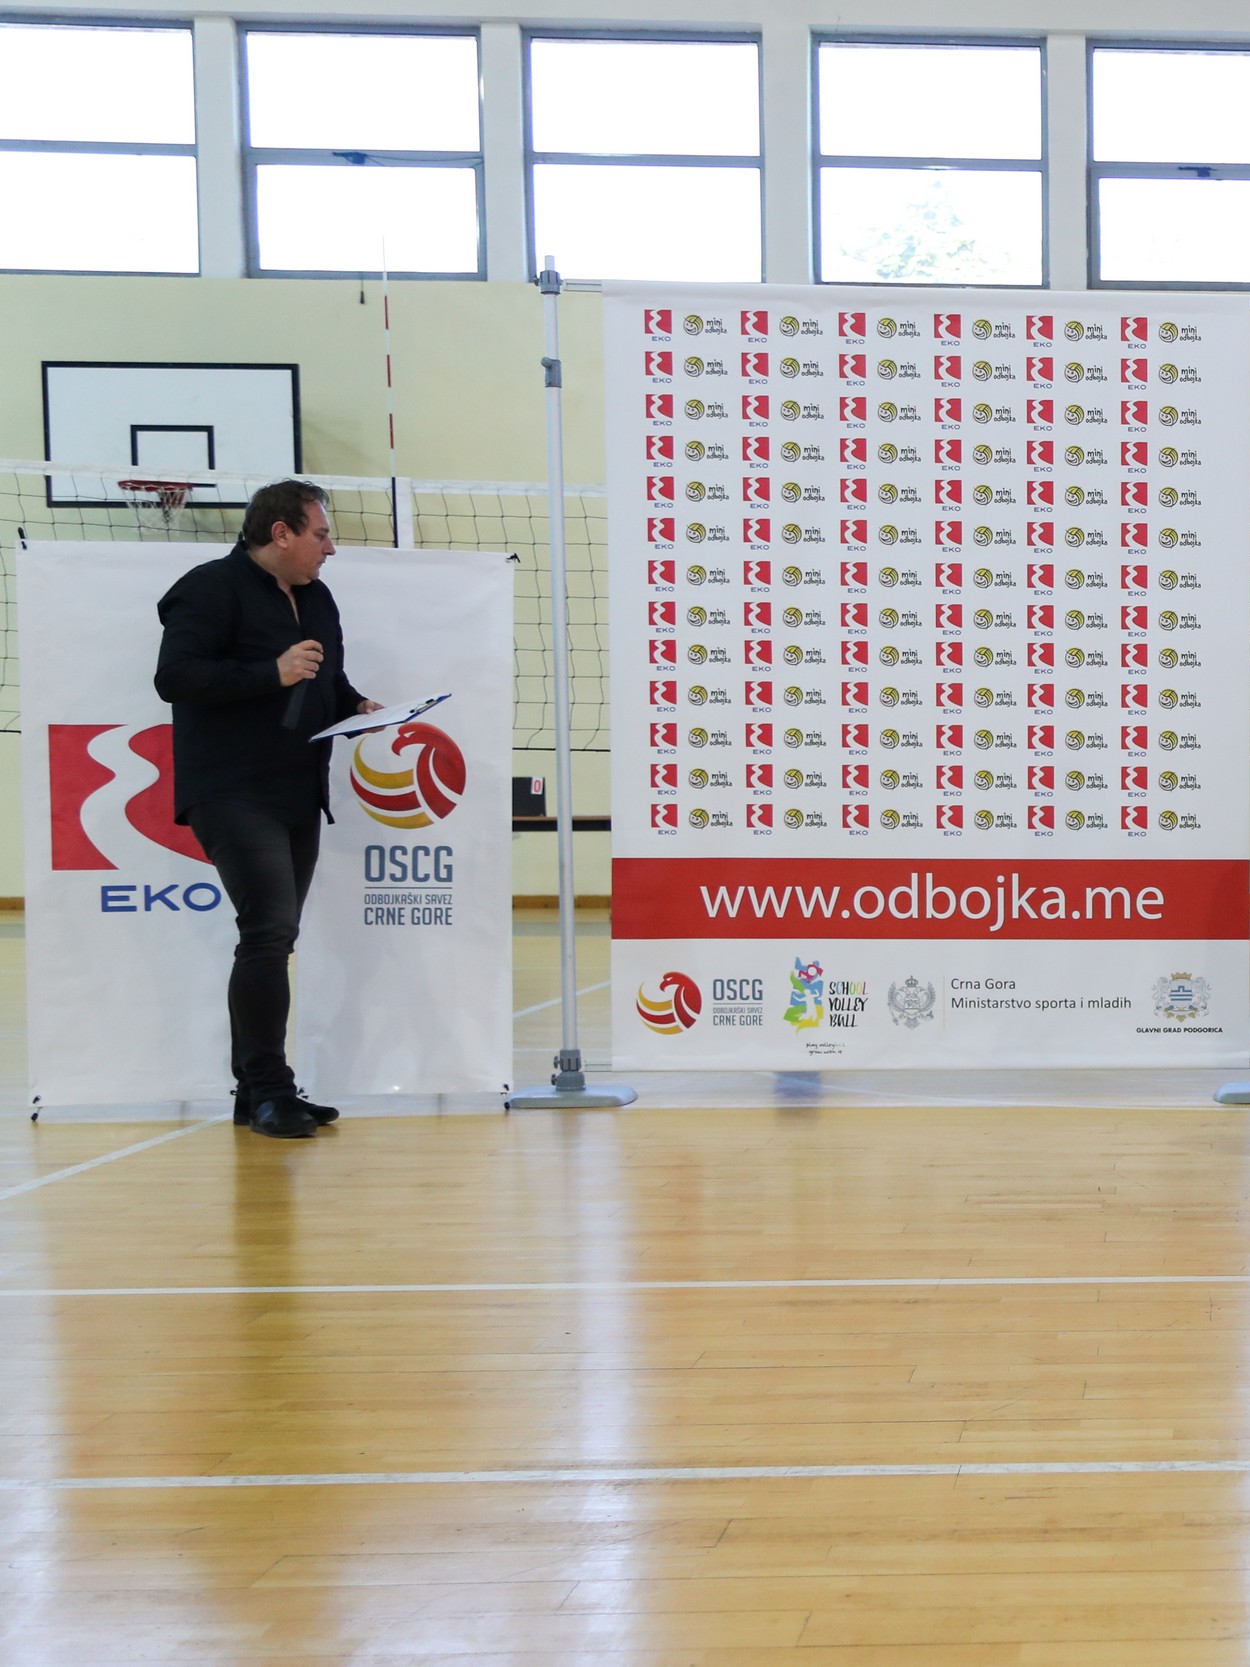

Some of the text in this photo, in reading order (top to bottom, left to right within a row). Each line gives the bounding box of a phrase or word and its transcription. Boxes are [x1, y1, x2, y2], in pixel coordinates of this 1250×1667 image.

[942, 464, 962, 472] EKO
[752, 706, 772, 714] EKO
[364, 845, 453, 882] OSCG
[100, 882, 222, 912] EKO
[364, 892, 452, 905] ODBOJKAŠKI SAVEZ
[700, 873, 1164, 931] www.odbojka.me
[364, 907, 452, 925] CRNE GORE
[713, 979, 763, 1000] OSCG
[829, 981, 868, 995] SCHOOL
[951, 978, 1015, 989] Crna Gora
[828, 997, 868, 1012] VOLLEY
[952, 997, 1031, 1008] Ministarstvo
[1035, 999, 1076, 1011] sporta
[1088, 997, 1131, 1008] mladih
[713, 1015, 763, 1026] CRNE GORE
[829, 1014, 858, 1028] BALL
